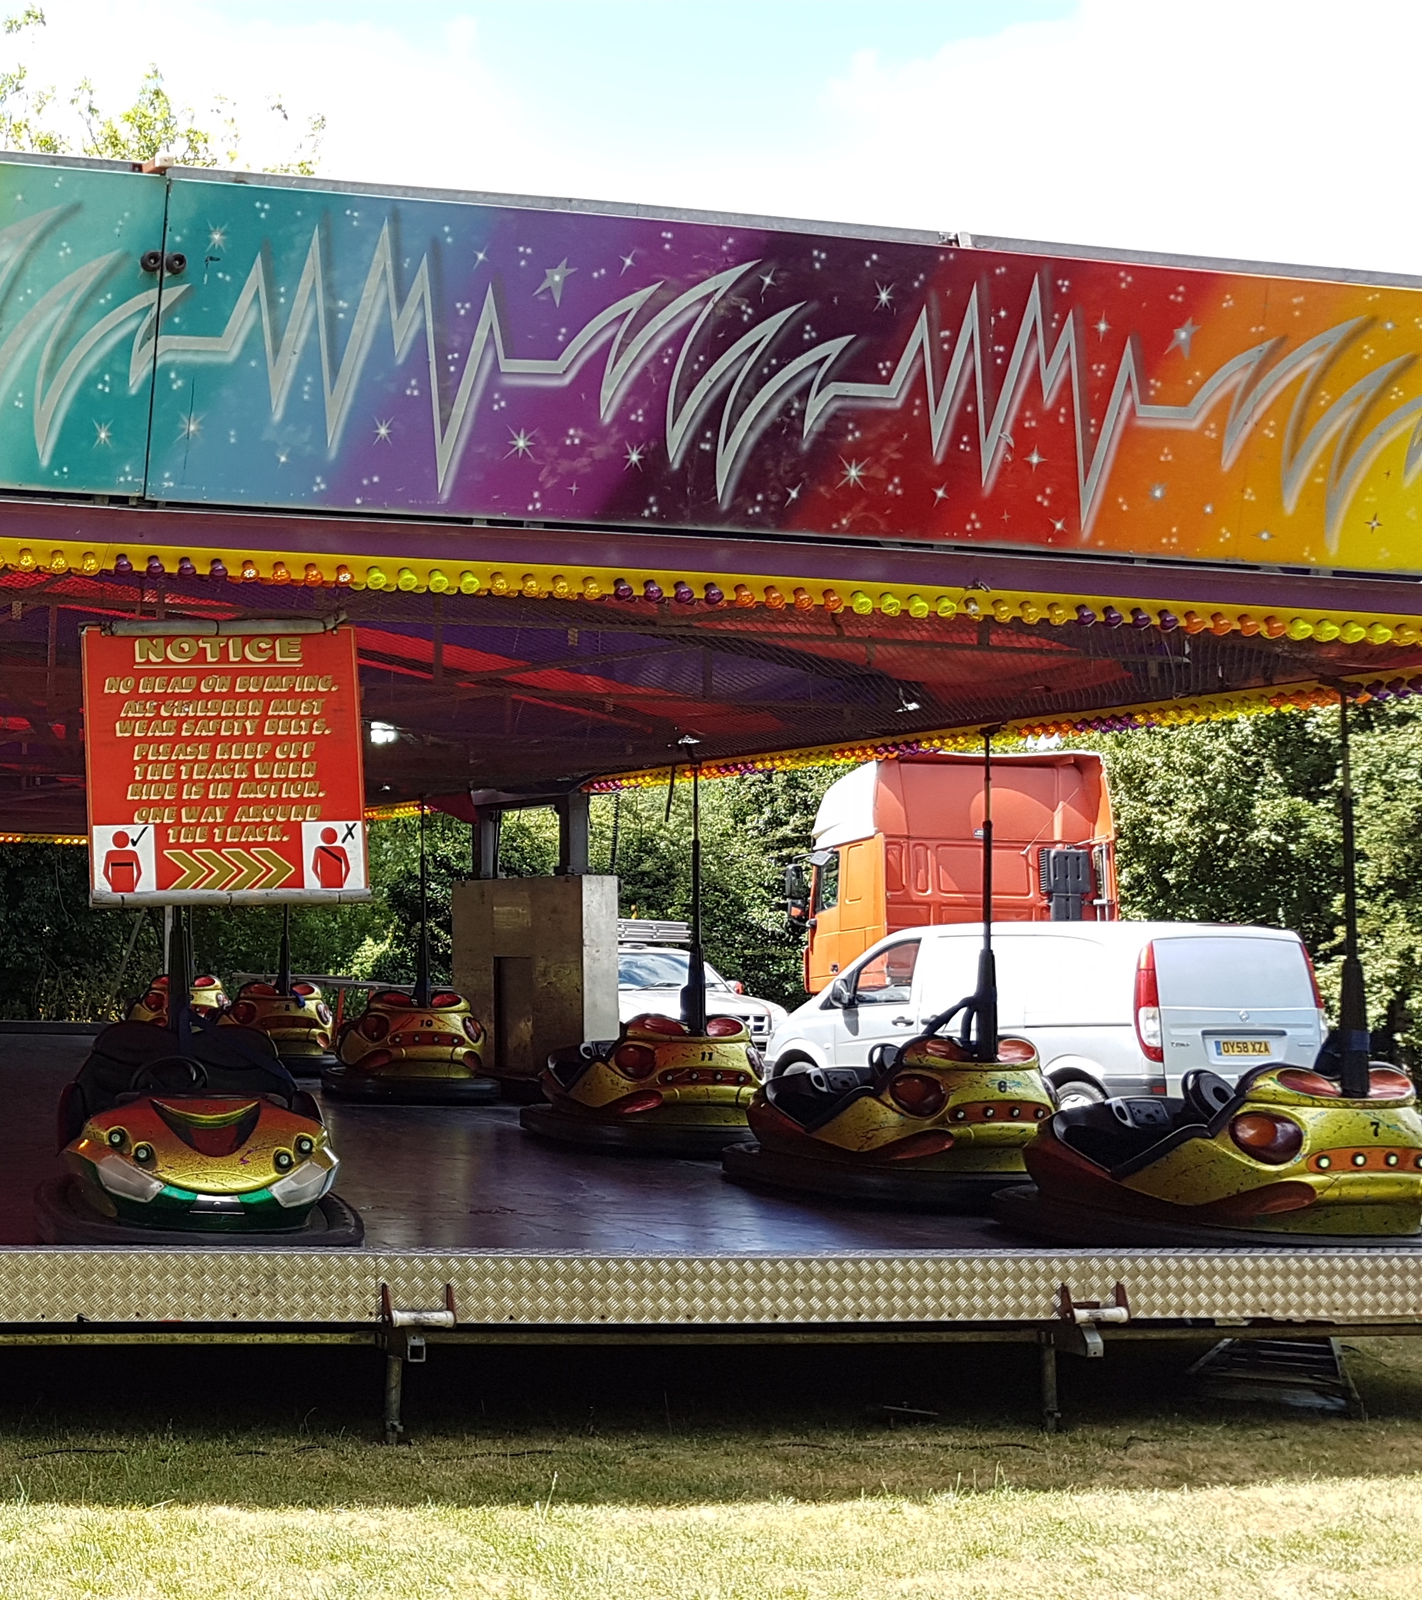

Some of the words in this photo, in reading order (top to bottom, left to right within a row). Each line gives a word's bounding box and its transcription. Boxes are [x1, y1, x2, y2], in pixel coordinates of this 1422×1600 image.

[135, 637, 302, 662] NOTICE
[104, 676, 135, 694] NO
[138, 676, 197, 693] HEAD
[200, 675, 232, 693] ON
[235, 675, 339, 693] BUMPING.
[120, 700, 158, 718] ALL
[160, 699, 264, 717] CHILDREN
[268, 698, 326, 716] MUST
[115, 719, 178, 737] WEAR
[181, 719, 259, 736] SAFETY
[264, 718, 332, 736] BELTS.
[133, 743, 211, 761] PLEASE
[215, 742, 272, 760] KEEP
[275, 741, 316, 759] OFF
[134, 763, 177, 780] THE
[180, 762, 251, 780] TRACK
[254, 761, 317, 779] WHEN
[126, 783, 178, 800] RIDE
[181, 783, 205, 800] IS
[208, 782, 233, 799] IN
[237, 781, 327, 798] MOTION.
[133, 806, 178, 824] ONE
[181, 805, 229, 823] WAY
[234, 804, 322, 822] AROUND
[167, 826, 210, 843] THE
[213, 825, 290, 843] TRACK.
[419, 1019, 433, 1028] 10
[701, 1051, 713, 1062] 11
[1222, 1041, 1249, 1053] OY58
[1250, 1041, 1270, 1053] XZA
[1371, 1121, 1380, 1137] 7
